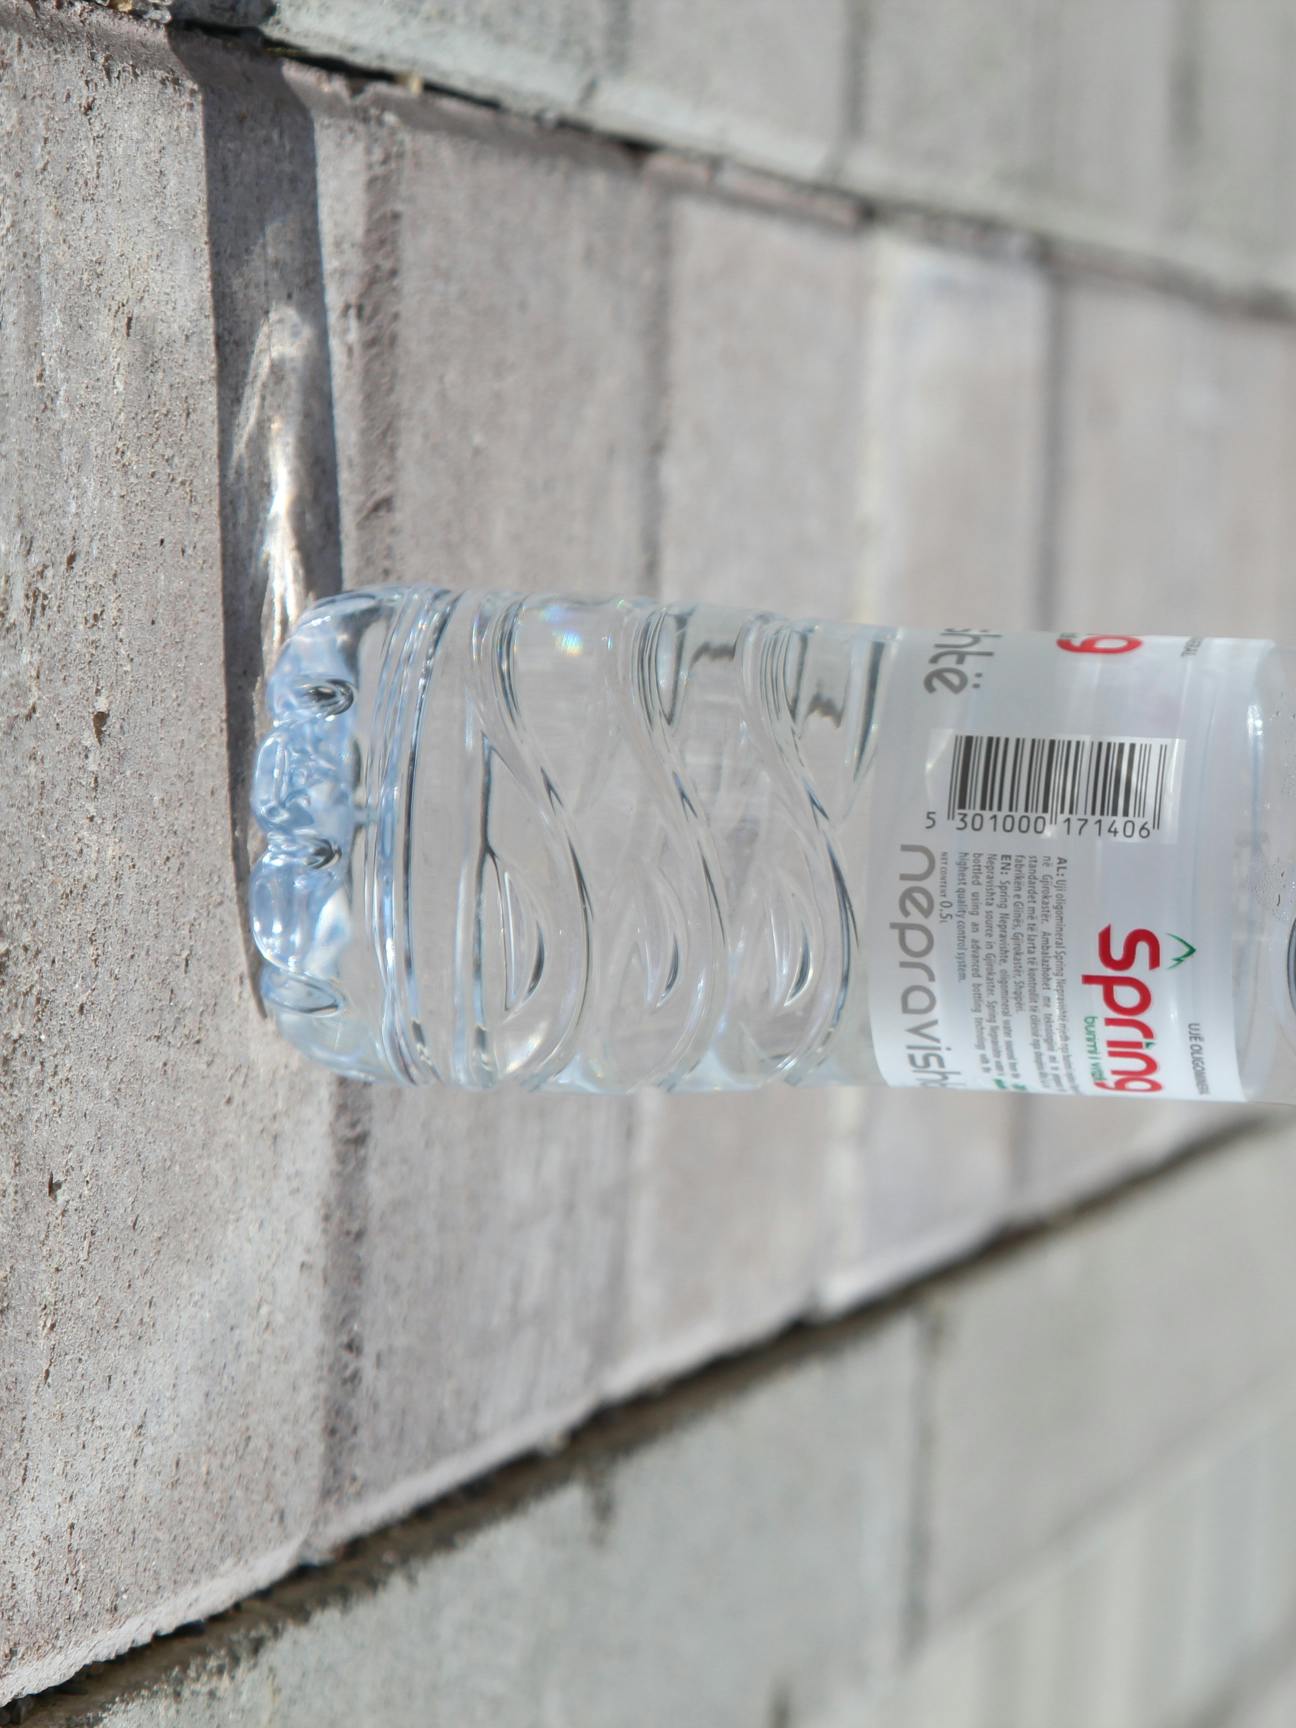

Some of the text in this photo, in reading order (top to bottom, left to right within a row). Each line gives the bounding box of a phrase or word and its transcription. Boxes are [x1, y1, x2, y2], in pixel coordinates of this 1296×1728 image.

[925, 811, 1150, 839] 5 301000 171406
[972, 853, 984, 885] bottled
[1001, 854, 1011, 875] EN:
[1014, 855, 1026, 891] fabrikën
[1056, 856, 1068, 876] AL:
[984, 854, 998, 906] Nepravishta
[996, 880, 1010, 909] Spring
[1027, 856, 1038, 904] standardet
[955, 852, 970, 982] highest quality control system.
[968, 892, 981, 916] using
[971, 922, 979, 933] an
[985, 910, 994, 938] source
[1052, 893, 1066, 948] oligomineral
[971, 939, 982, 978] advanced
[985, 941, 996, 949] in
[1027, 935, 1038, 954] larta
[1041, 932, 1053, 990] Ambalazhohet
[1052, 950, 1066, 977] Spring
[997, 969, 1012, 1016] oligomineral
[1082, 924, 1164, 1092] Spring
[1188, 1023, 1205, 1042] UJË
